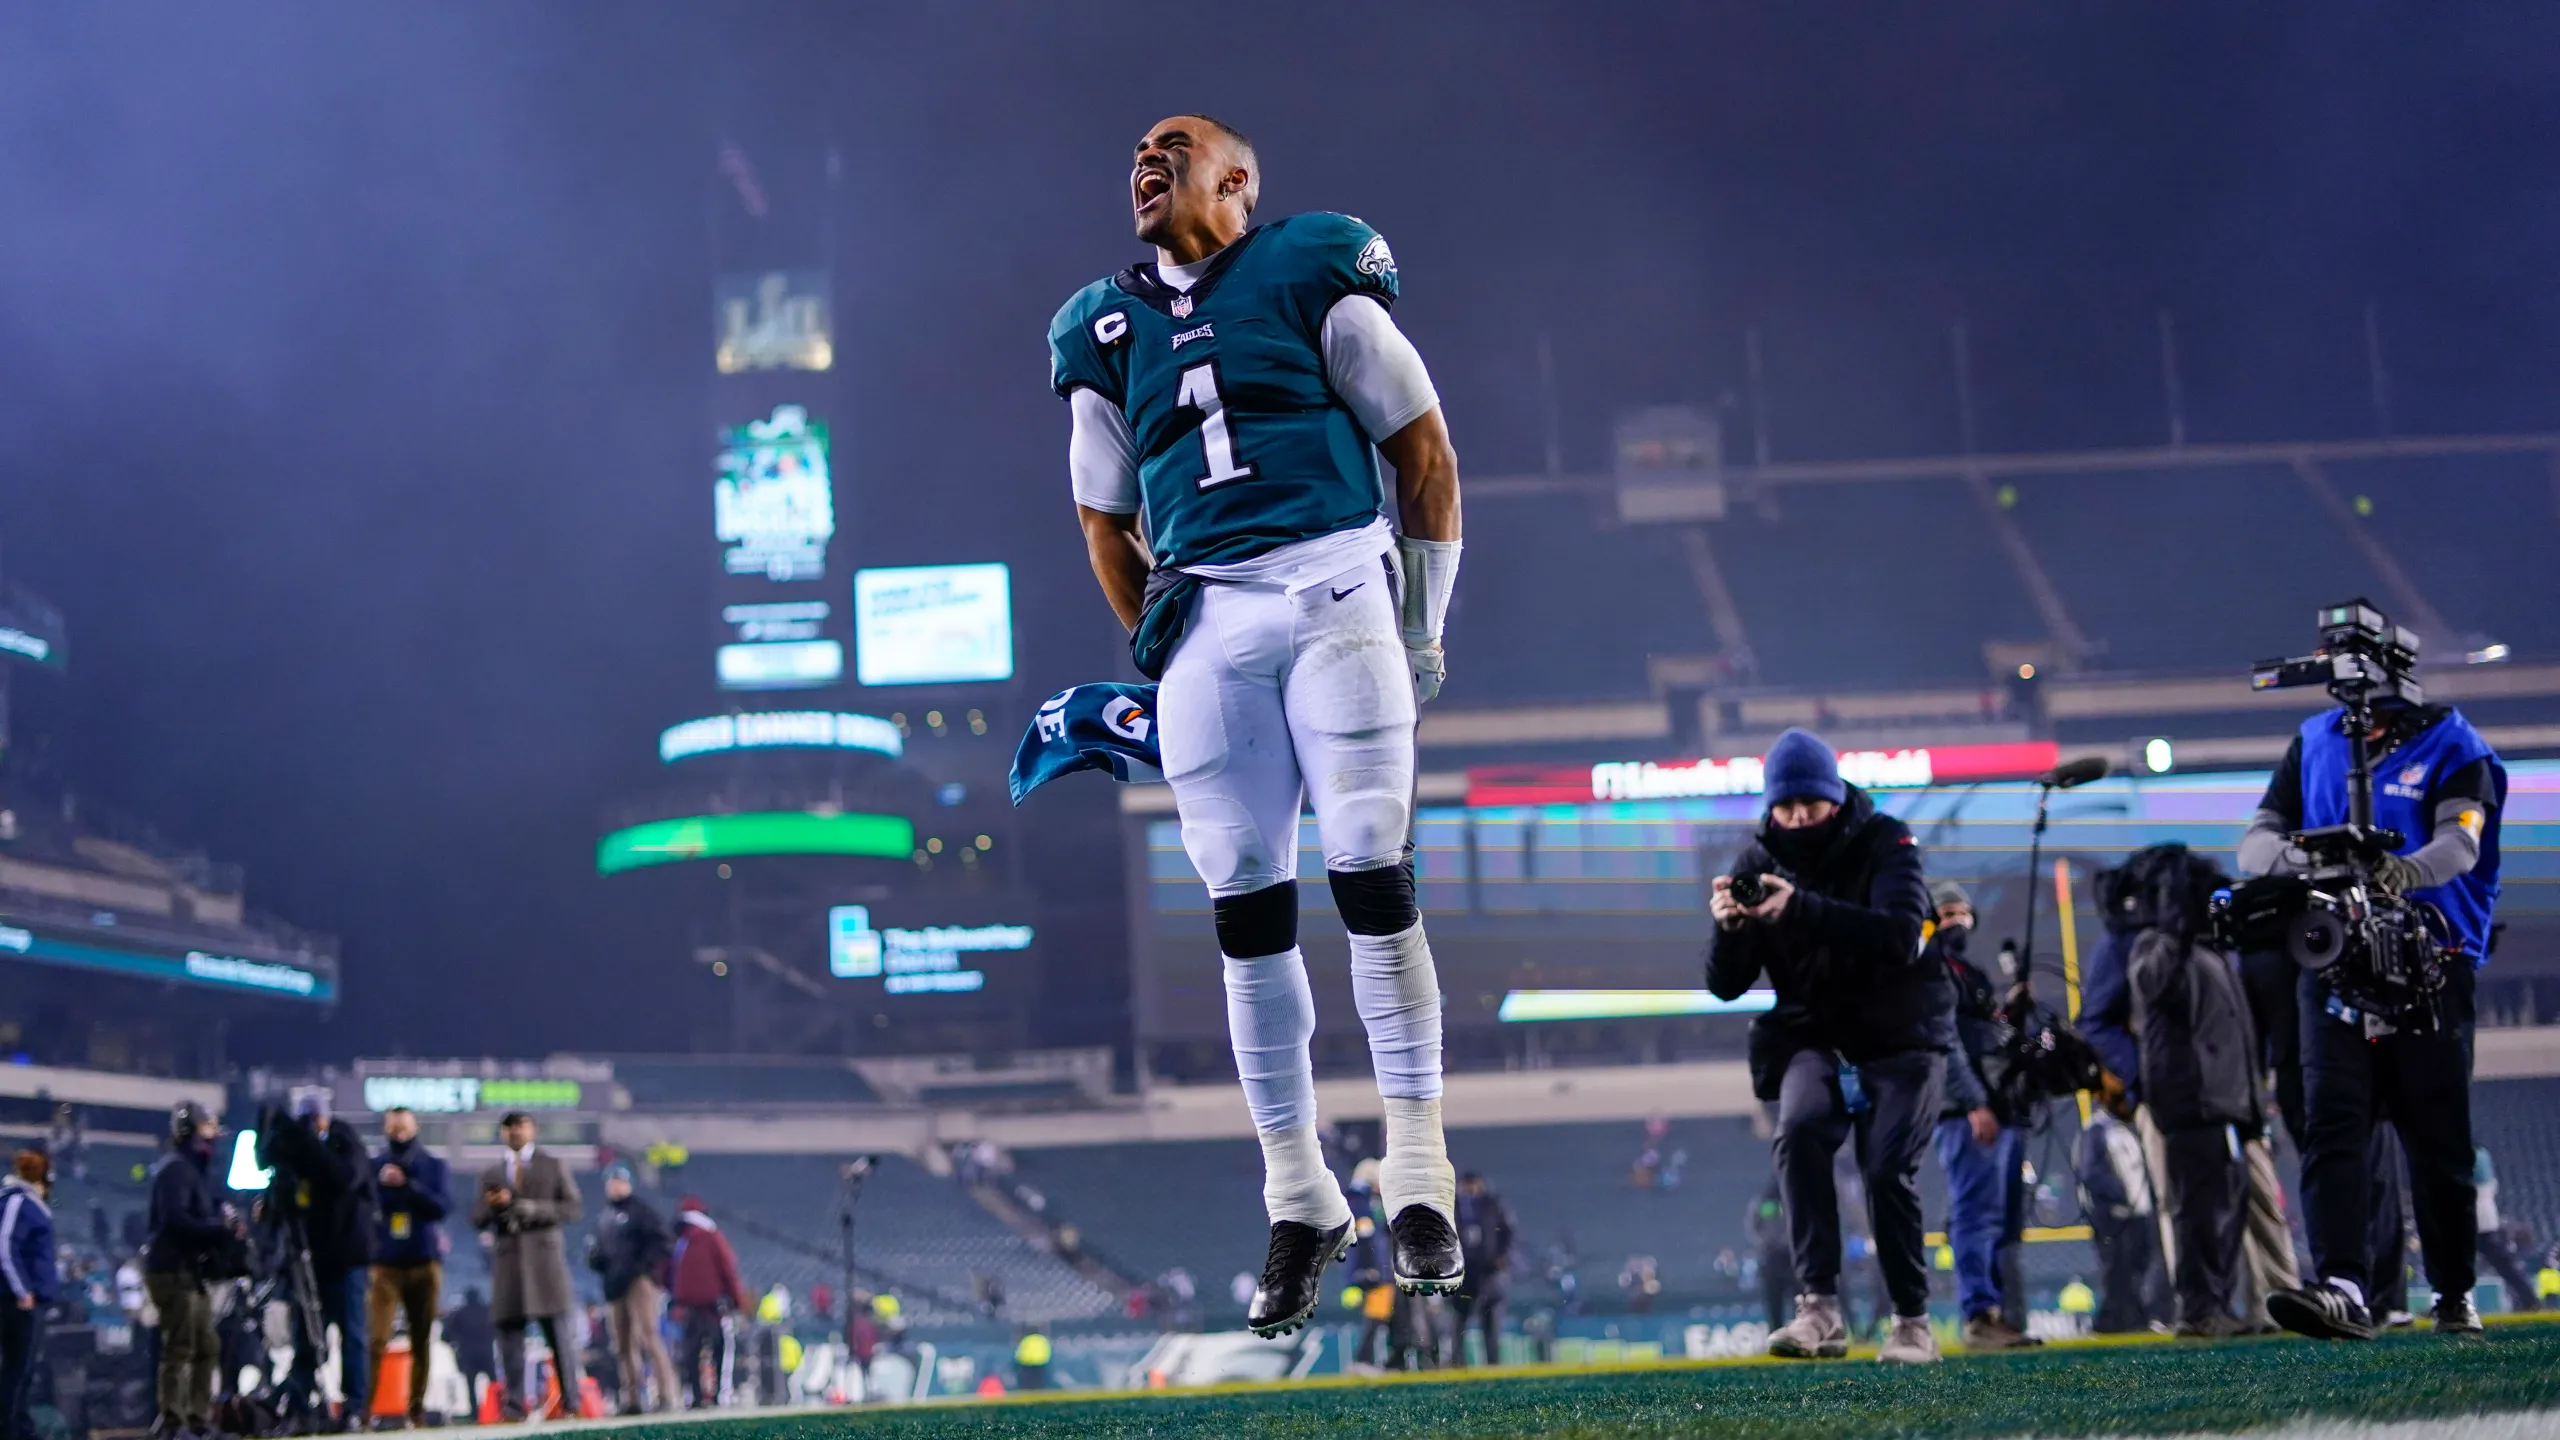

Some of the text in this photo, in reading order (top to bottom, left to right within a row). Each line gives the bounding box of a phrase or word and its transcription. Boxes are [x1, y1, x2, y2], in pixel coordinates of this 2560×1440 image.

[1094, 311, 1128, 344] C
[1171, 322, 1215, 351] EAGLES
[1176, 361, 1253, 491] 1
